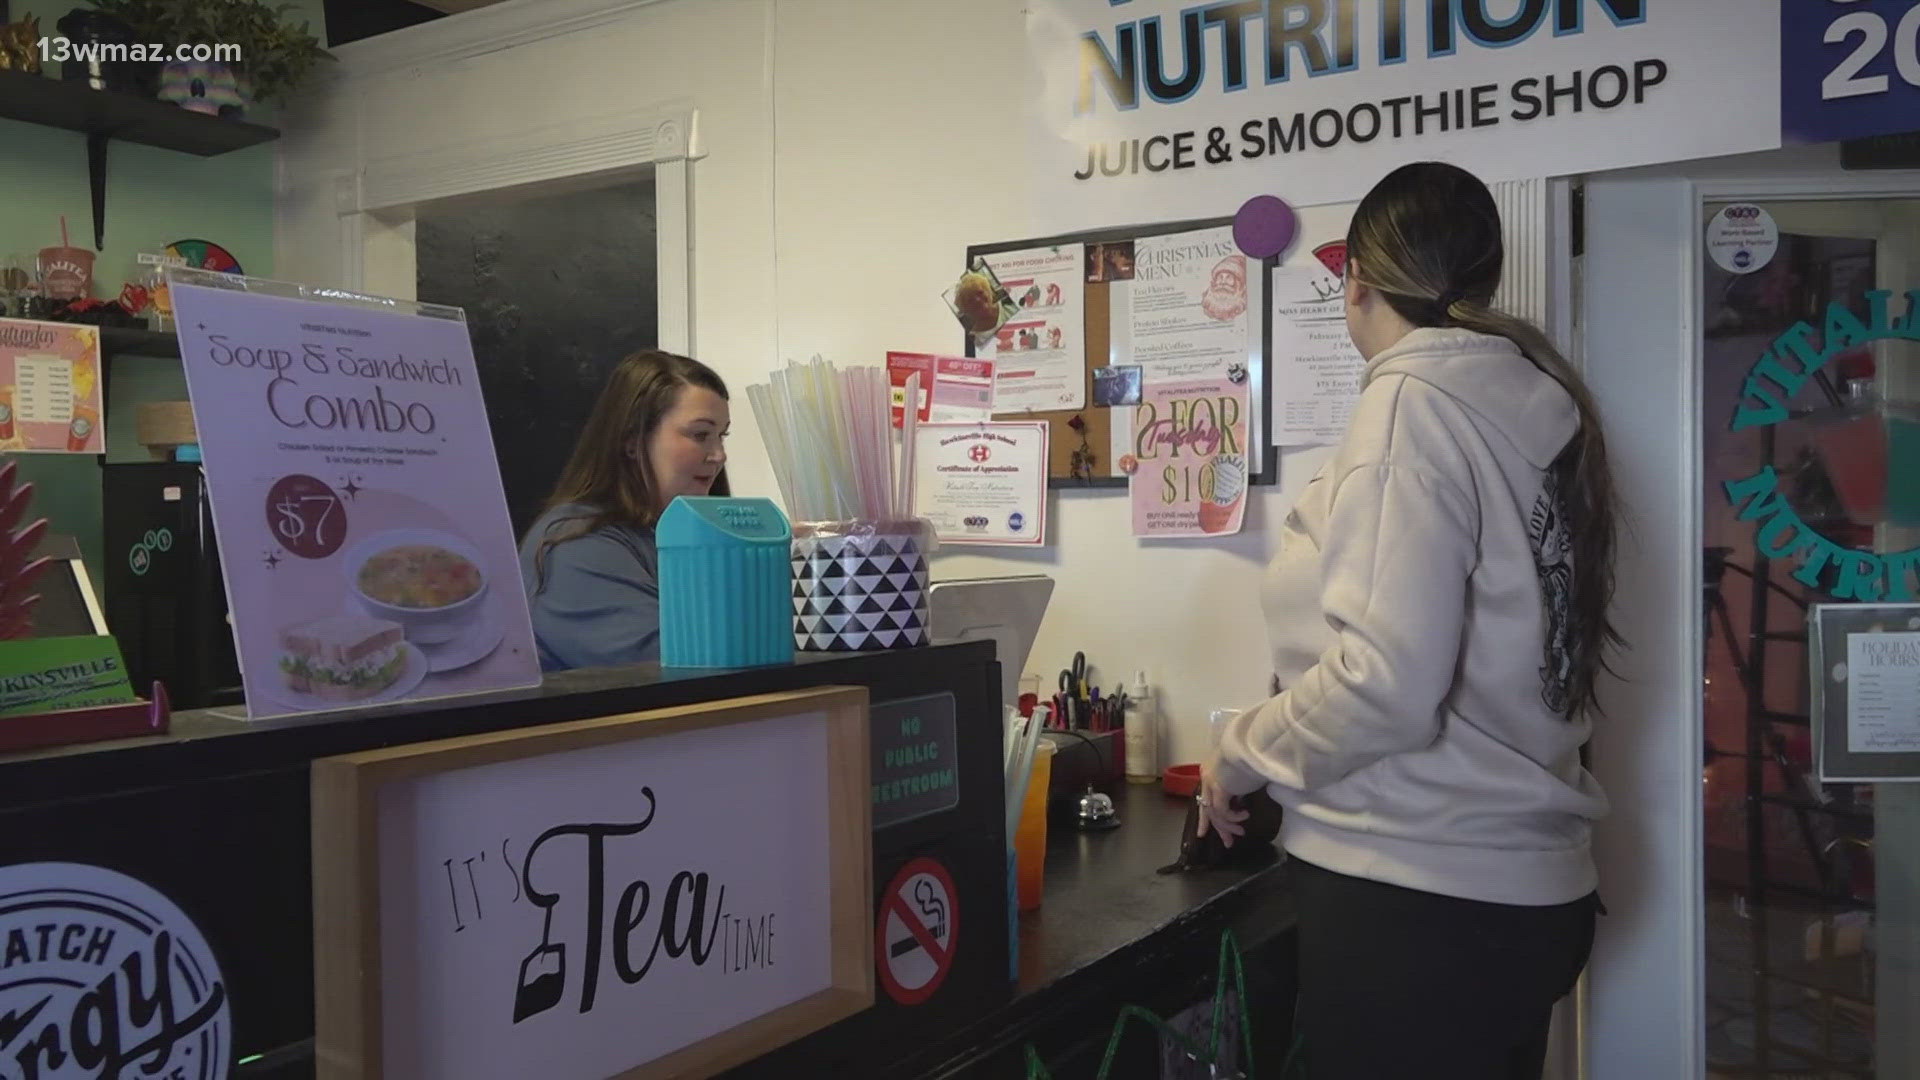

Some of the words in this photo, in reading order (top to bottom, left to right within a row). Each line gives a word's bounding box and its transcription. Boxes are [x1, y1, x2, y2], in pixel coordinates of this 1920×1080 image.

[1074, 131, 1195, 180] JUICE
[1204, 126, 1232, 164] &
[1240, 83, 1499, 159] SMOOTHIE
[1510, 58, 1668, 121] SHOP
[1134, 240, 1233, 267] CHRISTMAS
[1135, 264, 1183, 282] MENU
[1300, 306, 1327, 314] HEART
[0, 324, 58, 347] aturday
[208, 334, 293, 379] Soup
[301, 343, 330, 375] &
[335, 346, 462, 386] Sandwich
[267, 376, 436, 434] Combo
[939, 432, 981, 446] Hawkinsville
[983, 432, 996, 441] High
[997, 435, 1017, 446] School
[1136, 402, 1158, 460] 2
[1169, 396, 1240, 458] FOR
[980, 465, 1019, 474] Appreciation
[1162, 462, 1215, 505] $10
[276, 495, 336, 545] $7
[1529, 495, 1549, 542] LOVE
[0, 657, 117, 693] KINSVILLE
[1870, 653, 1920, 667] HOURS
[901, 716, 921, 737] NO
[884, 741, 939, 768] PUBLIC
[444, 838, 520, 933] IT'S
[522, 786, 725, 1015] Tea
[0, 924, 116, 969] ATCH
[721, 913, 776, 975] TIME
